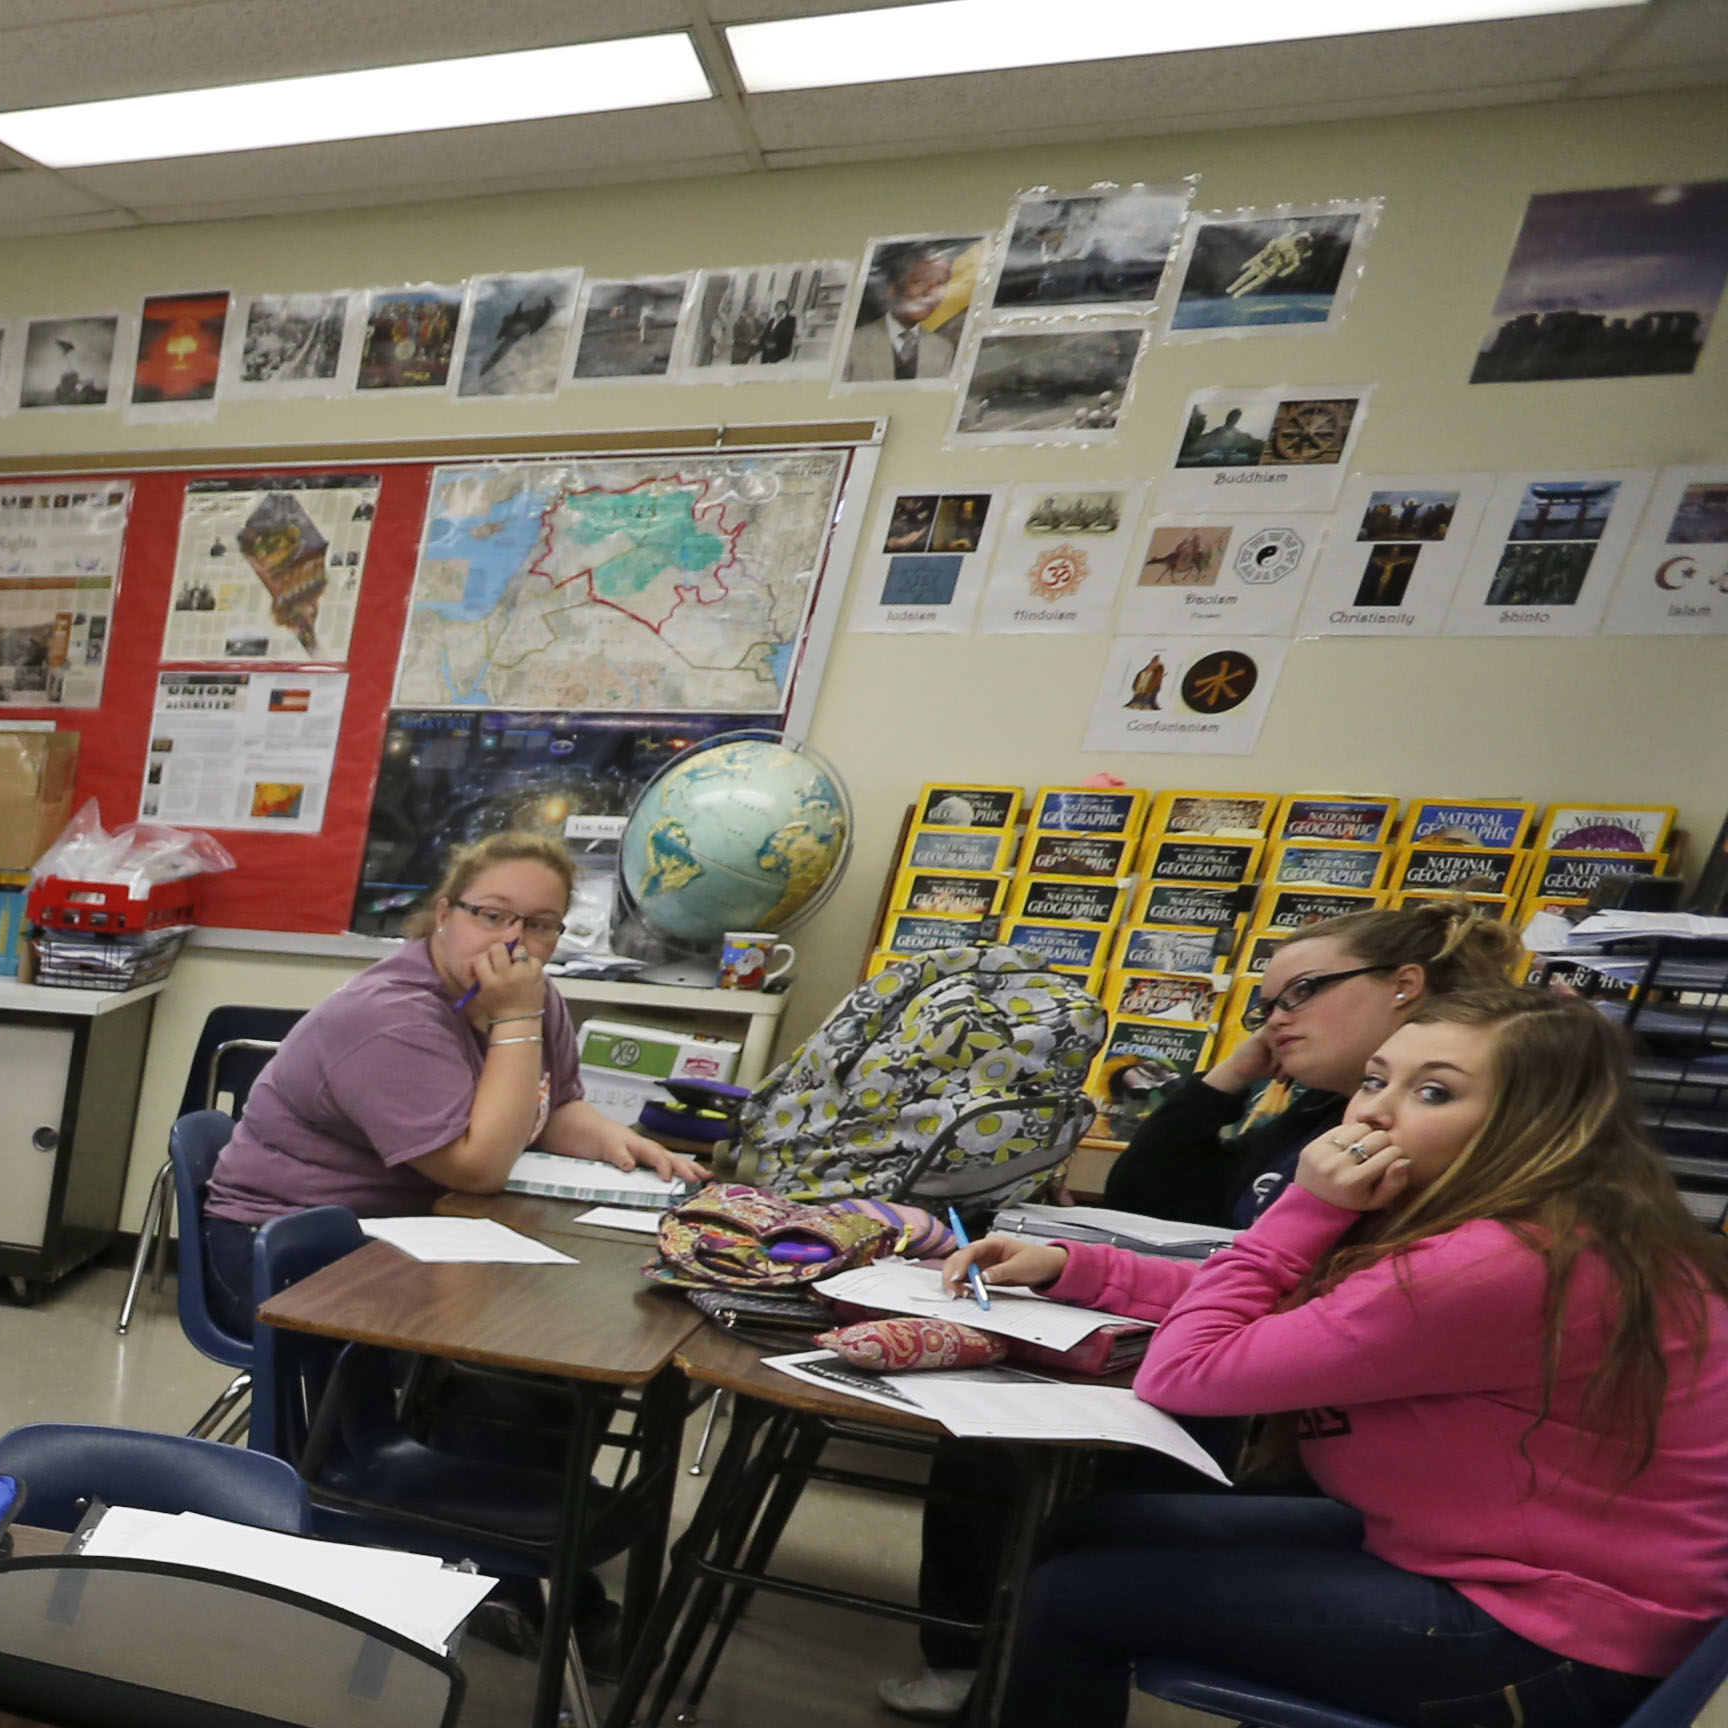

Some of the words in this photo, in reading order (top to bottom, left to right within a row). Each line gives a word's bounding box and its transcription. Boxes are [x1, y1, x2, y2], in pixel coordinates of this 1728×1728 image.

[1214, 472, 1288, 484] Buddhism
[1185, 594, 1238, 605] Daoism
[886, 610, 936, 622] Judaism
[1013, 610, 1077, 621] Hinduism
[1499, 611, 1550, 623] Shinto
[1668, 604, 1711, 617] Islam
[1329, 611, 1415, 626] Christianity
[168, 686, 237, 695] UNION
[1127, 720, 1220, 734] Confucianism
[1044, 811, 1124, 826] GEOGRAPHIC
[1310, 812, 1362, 823] NATIONAL
[1435, 811, 1502, 825] NATIONAL
[1289, 821, 1375, 837] GEOGRAPHIC
[915, 850, 995, 866] GEOGRAPHIC
[1177, 853, 1230, 864] NATIONAL
[1426, 856, 1493, 870] NATIONAL
[1157, 862, 1243, 878] GEOGRAPHIC
[1282, 867, 1371, 883] GEOGRAPHIC
[1544, 874, 1600, 889] GEOGR
[932, 884, 979, 896] NATIONAL
[913, 893, 990, 908] GEOGRAPHIC
[1047, 893, 1097, 905] NATIONAL
[1027, 902, 1109, 917] GEOGRAPHIC
[1150, 905, 1232, 921] GEOGRAPHIC
[1029, 935, 1079, 947] NATIONAL
[1132, 1034, 1184, 1047] NATIONAL
[1112, 1041, 1195, 1061] GEOGRAPHIC
